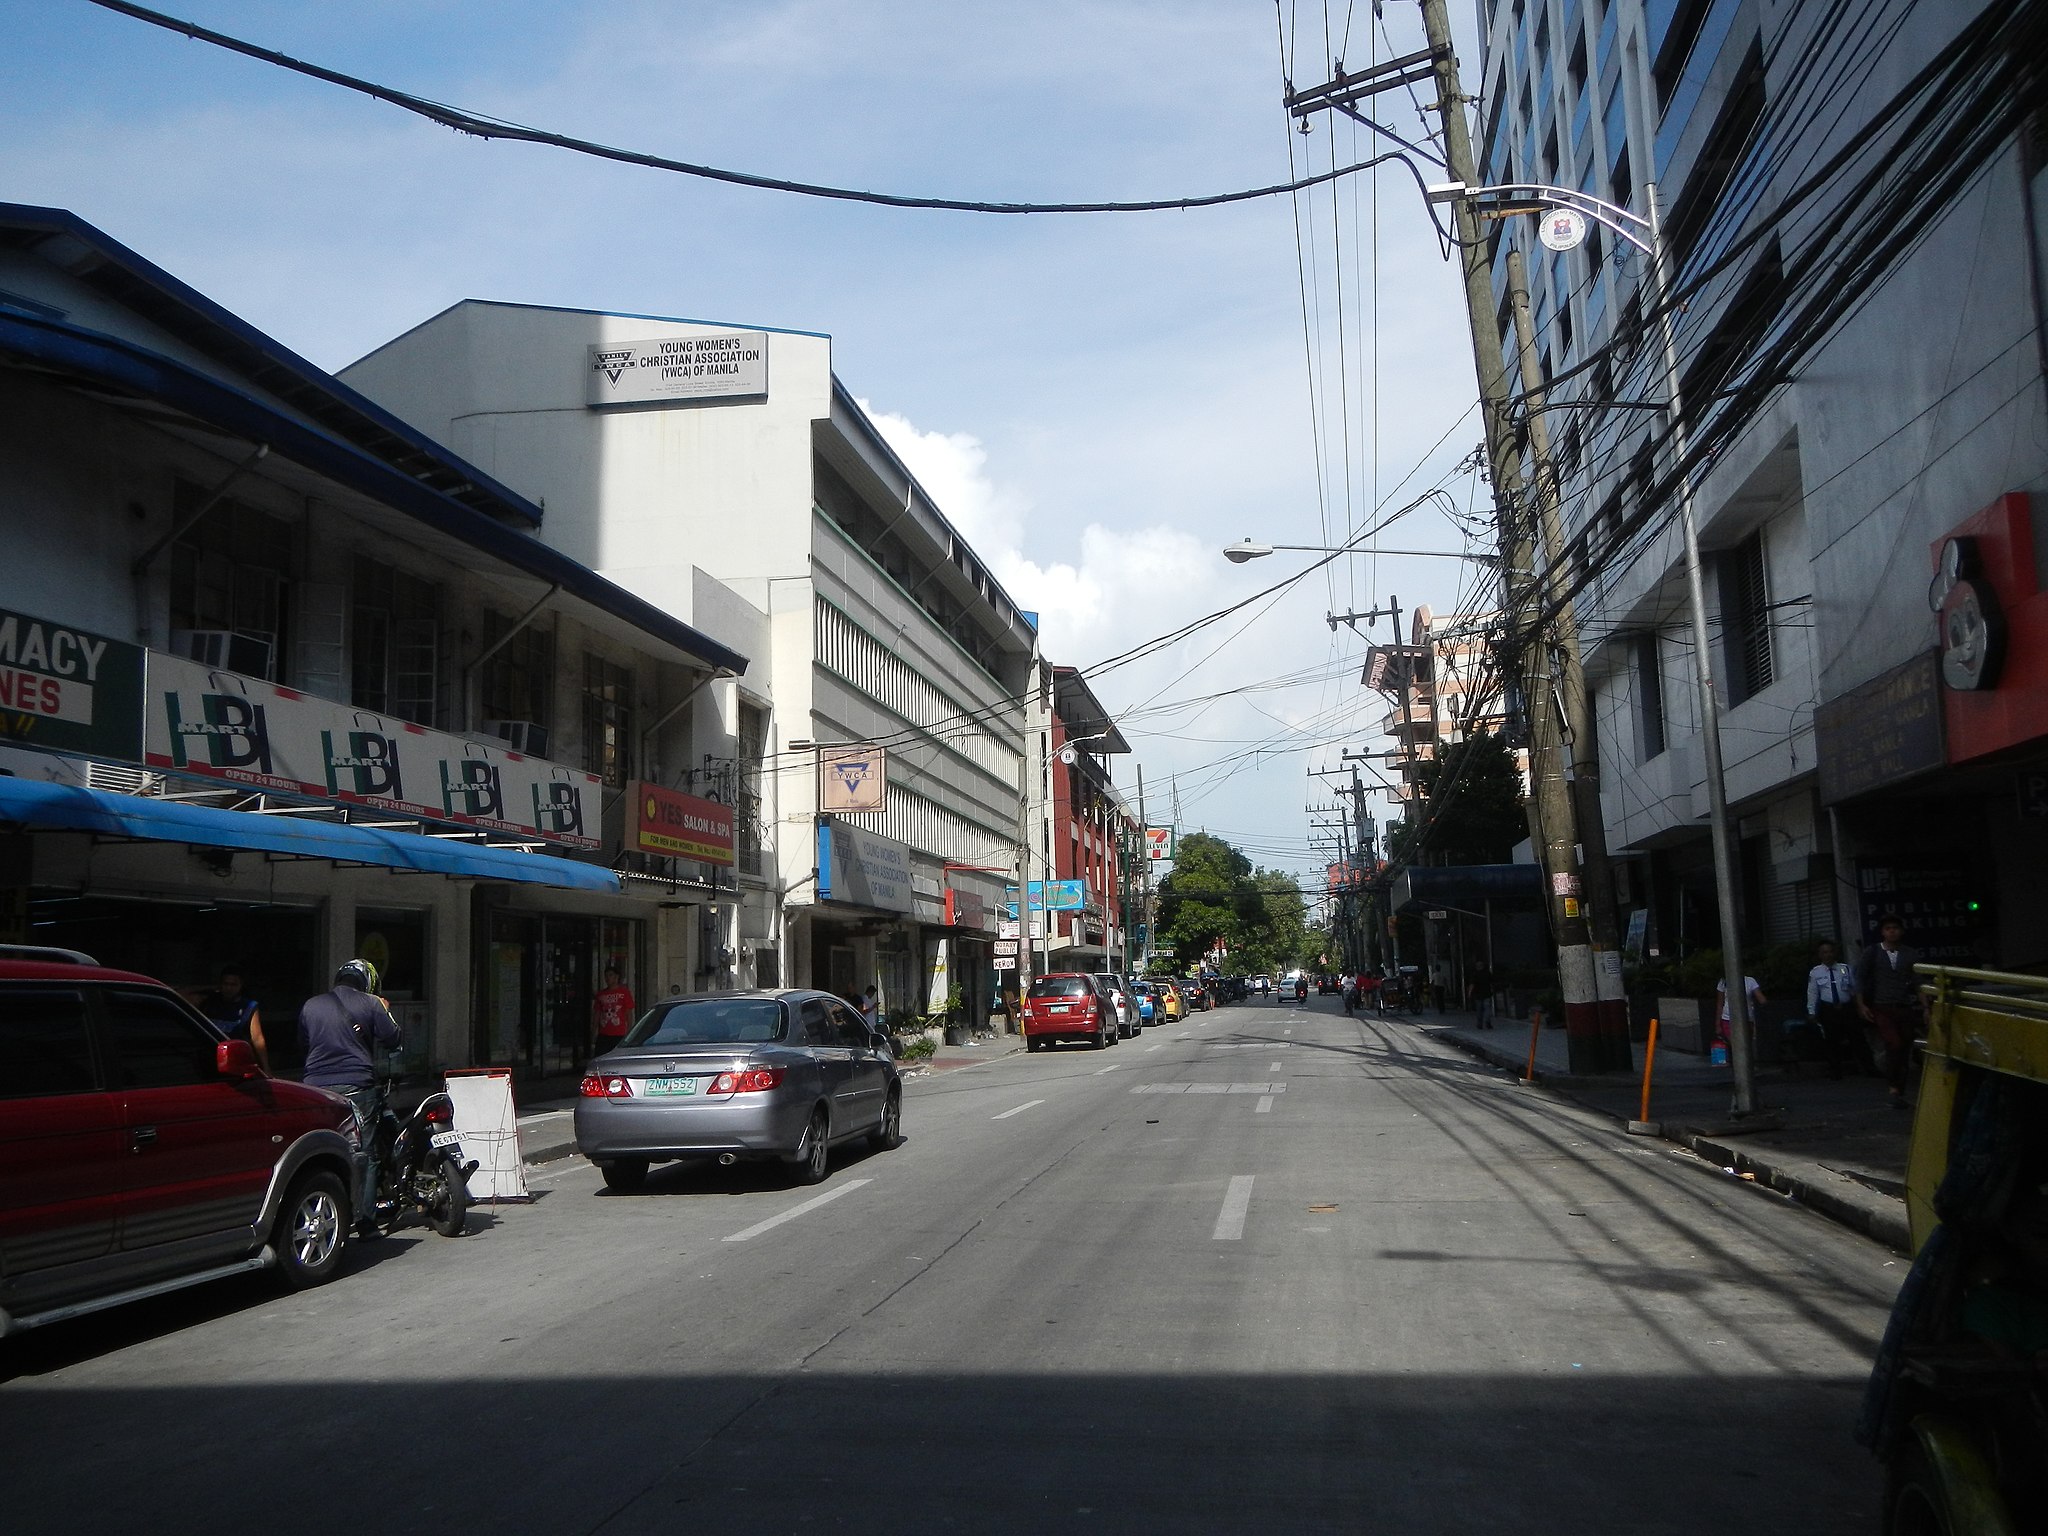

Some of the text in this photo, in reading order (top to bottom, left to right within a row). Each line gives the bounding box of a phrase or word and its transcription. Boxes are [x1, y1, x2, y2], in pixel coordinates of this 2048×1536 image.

[660, 338, 740, 354] YOUNG WOMEN'S
[640, 350, 759, 368] CHRISTIAN ASSOCIATION
[661, 363, 740, 381] (YWCA) OF MANILA
[178, 722, 247, 735] MART
[331, 757, 383, 767] MART
[225, 769, 301, 791] OPEN 24 HOURS
[446, 783, 488, 791] MART
[366, 797, 425, 814] OPEN 24 HOURS
[537, 803, 570, 811] MART
[660, 800, 730, 838] YES SALON & SPA
[863, 840, 880, 857] YOUNG
[880, 844, 901, 865] WOMEN'S
[855, 858, 909, 884] CHRISTIAN ASSOCIATION
[871, 880, 896, 899] OF MANILA
[1867, 900, 1966, 915] PUBLIC
[994, 960, 1014, 968] XEROX
